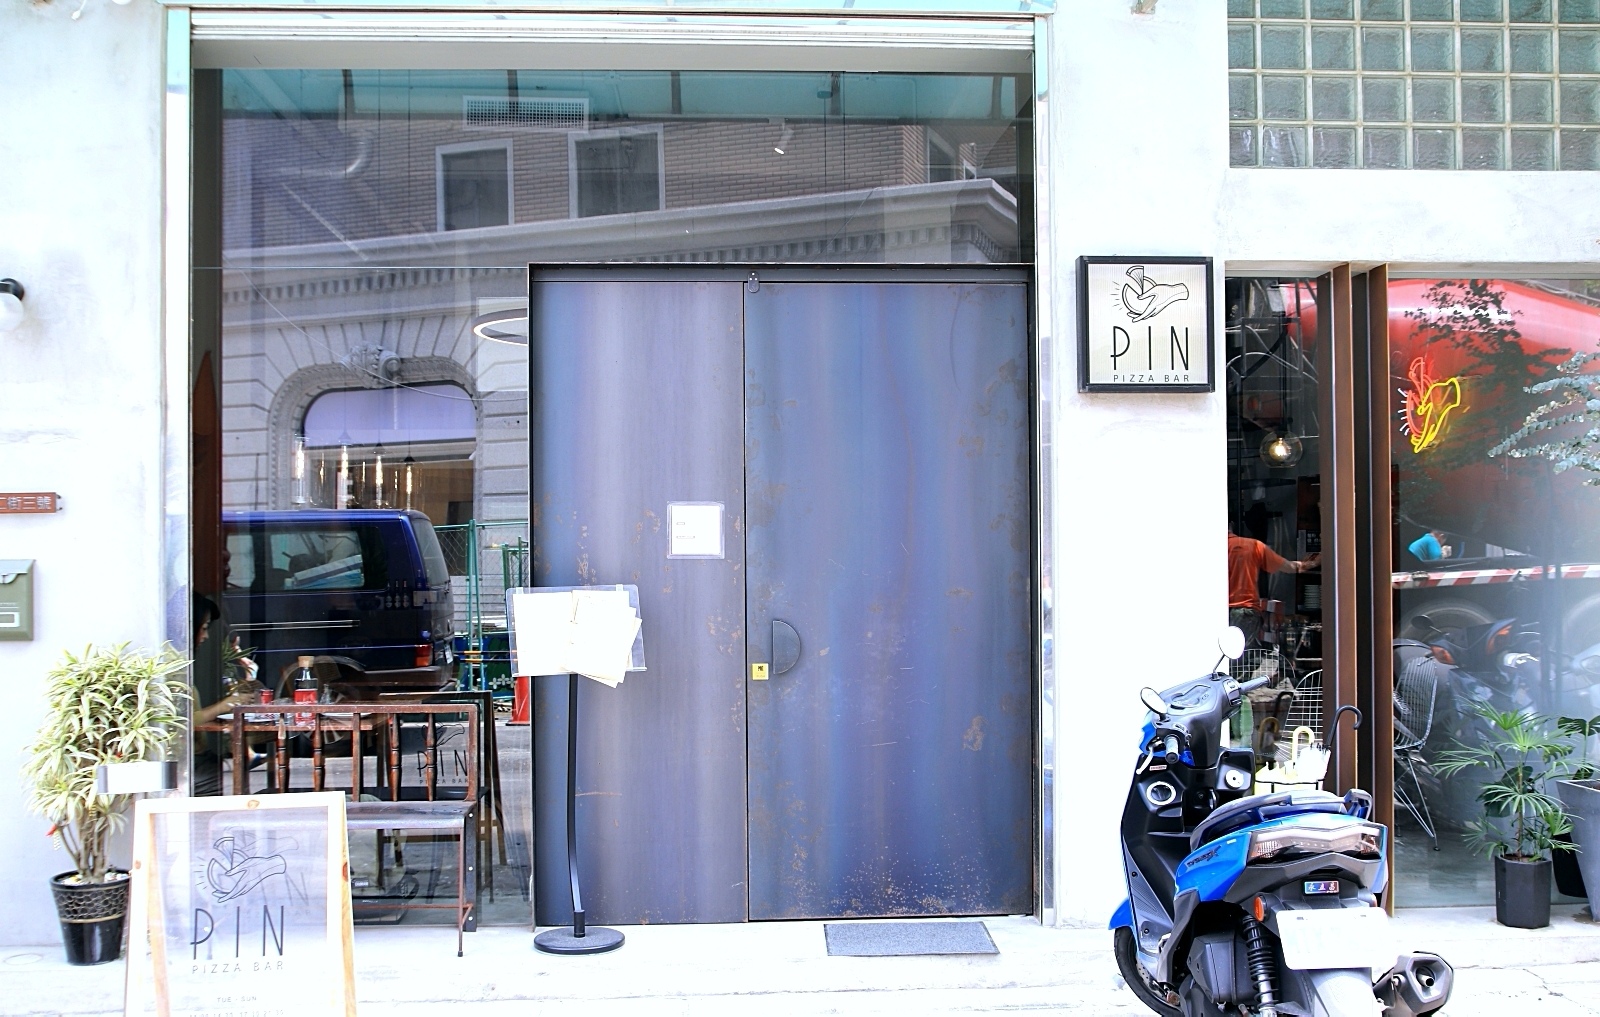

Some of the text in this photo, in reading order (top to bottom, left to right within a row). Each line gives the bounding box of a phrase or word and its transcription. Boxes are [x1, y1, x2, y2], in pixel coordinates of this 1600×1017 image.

[1110, 325, 1189, 371] PIN
[1113, 374, 1190, 383] PIZZA BAR
[189, 904, 284, 960] PIN
[191, 961, 284, 975] PIZZA BAR
